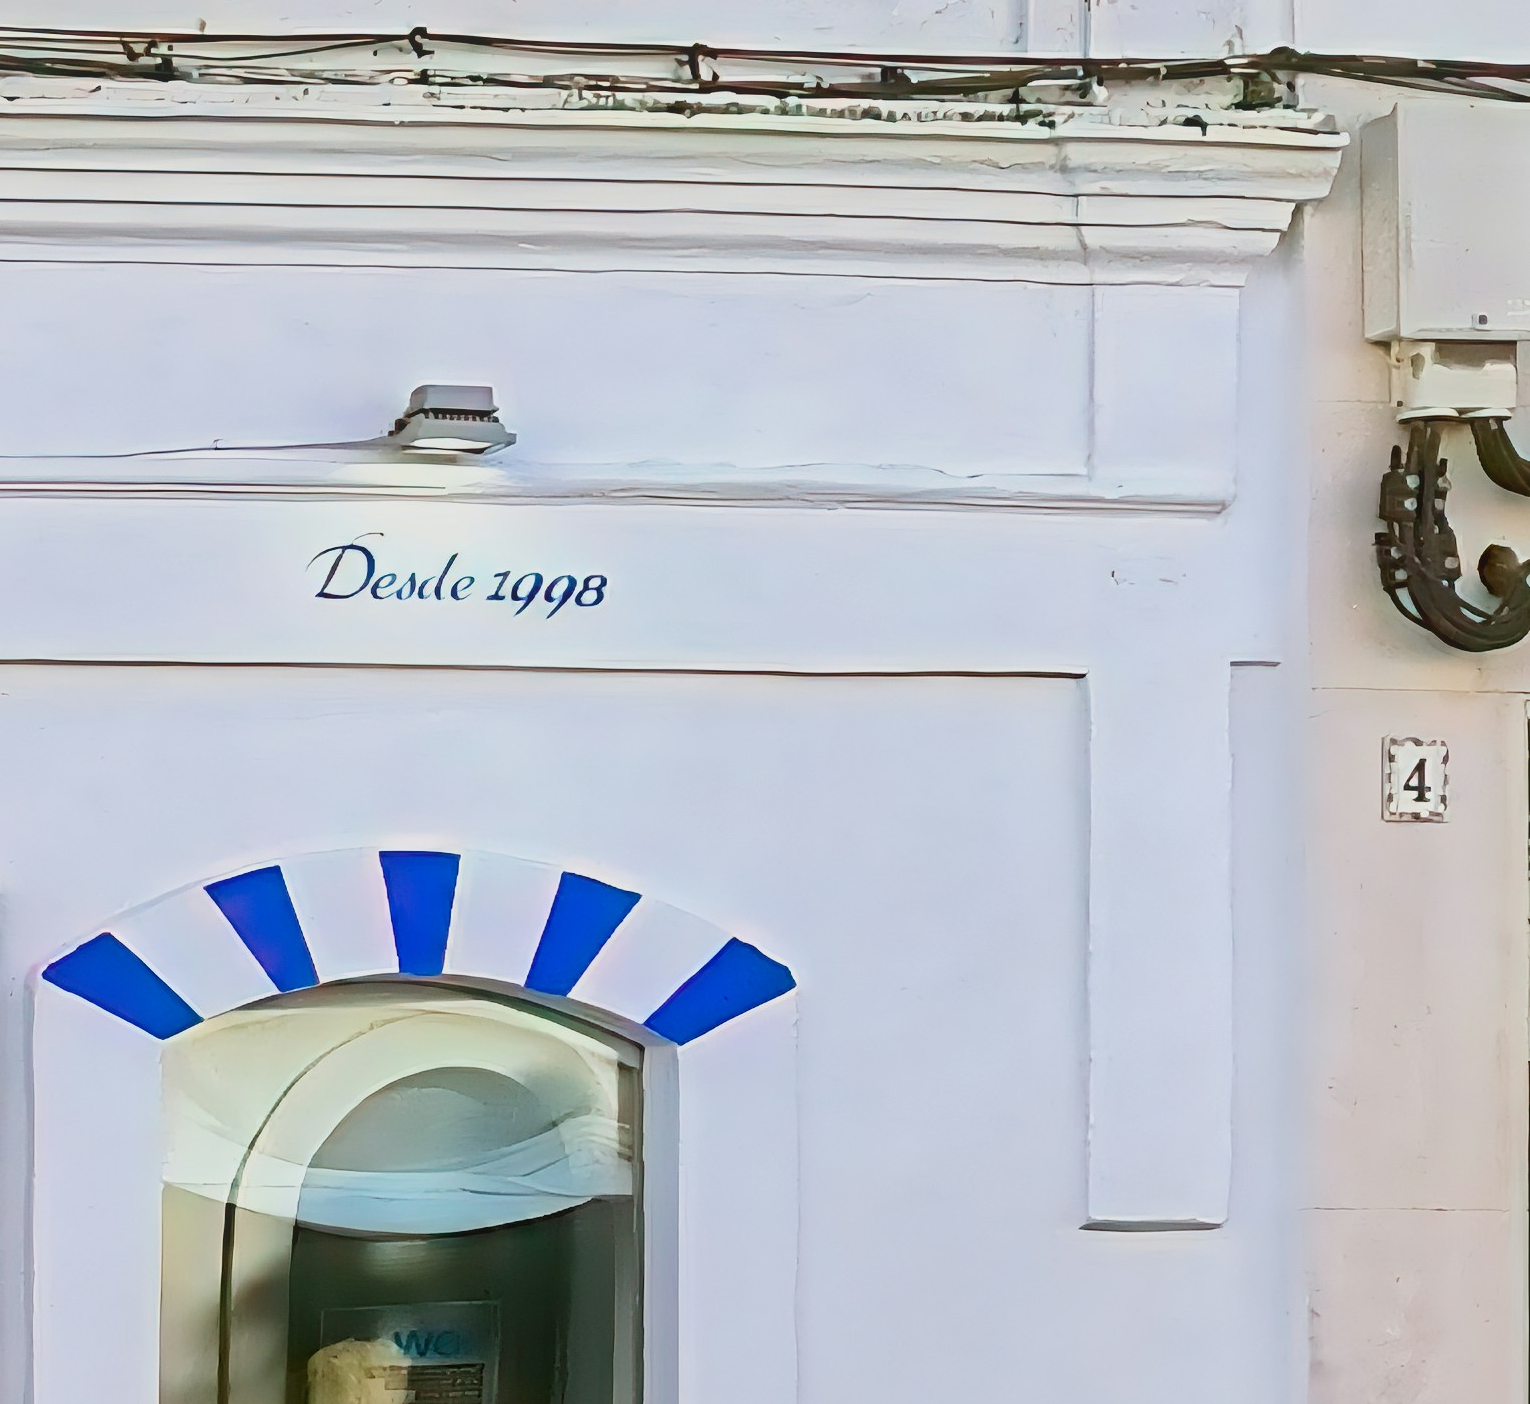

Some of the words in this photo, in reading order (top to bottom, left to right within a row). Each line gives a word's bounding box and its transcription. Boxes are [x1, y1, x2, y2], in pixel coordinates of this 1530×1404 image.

[305, 532, 476, 601] Desde
[485, 570, 608, 620] 1998
[1403, 758, 1431, 802] 4
